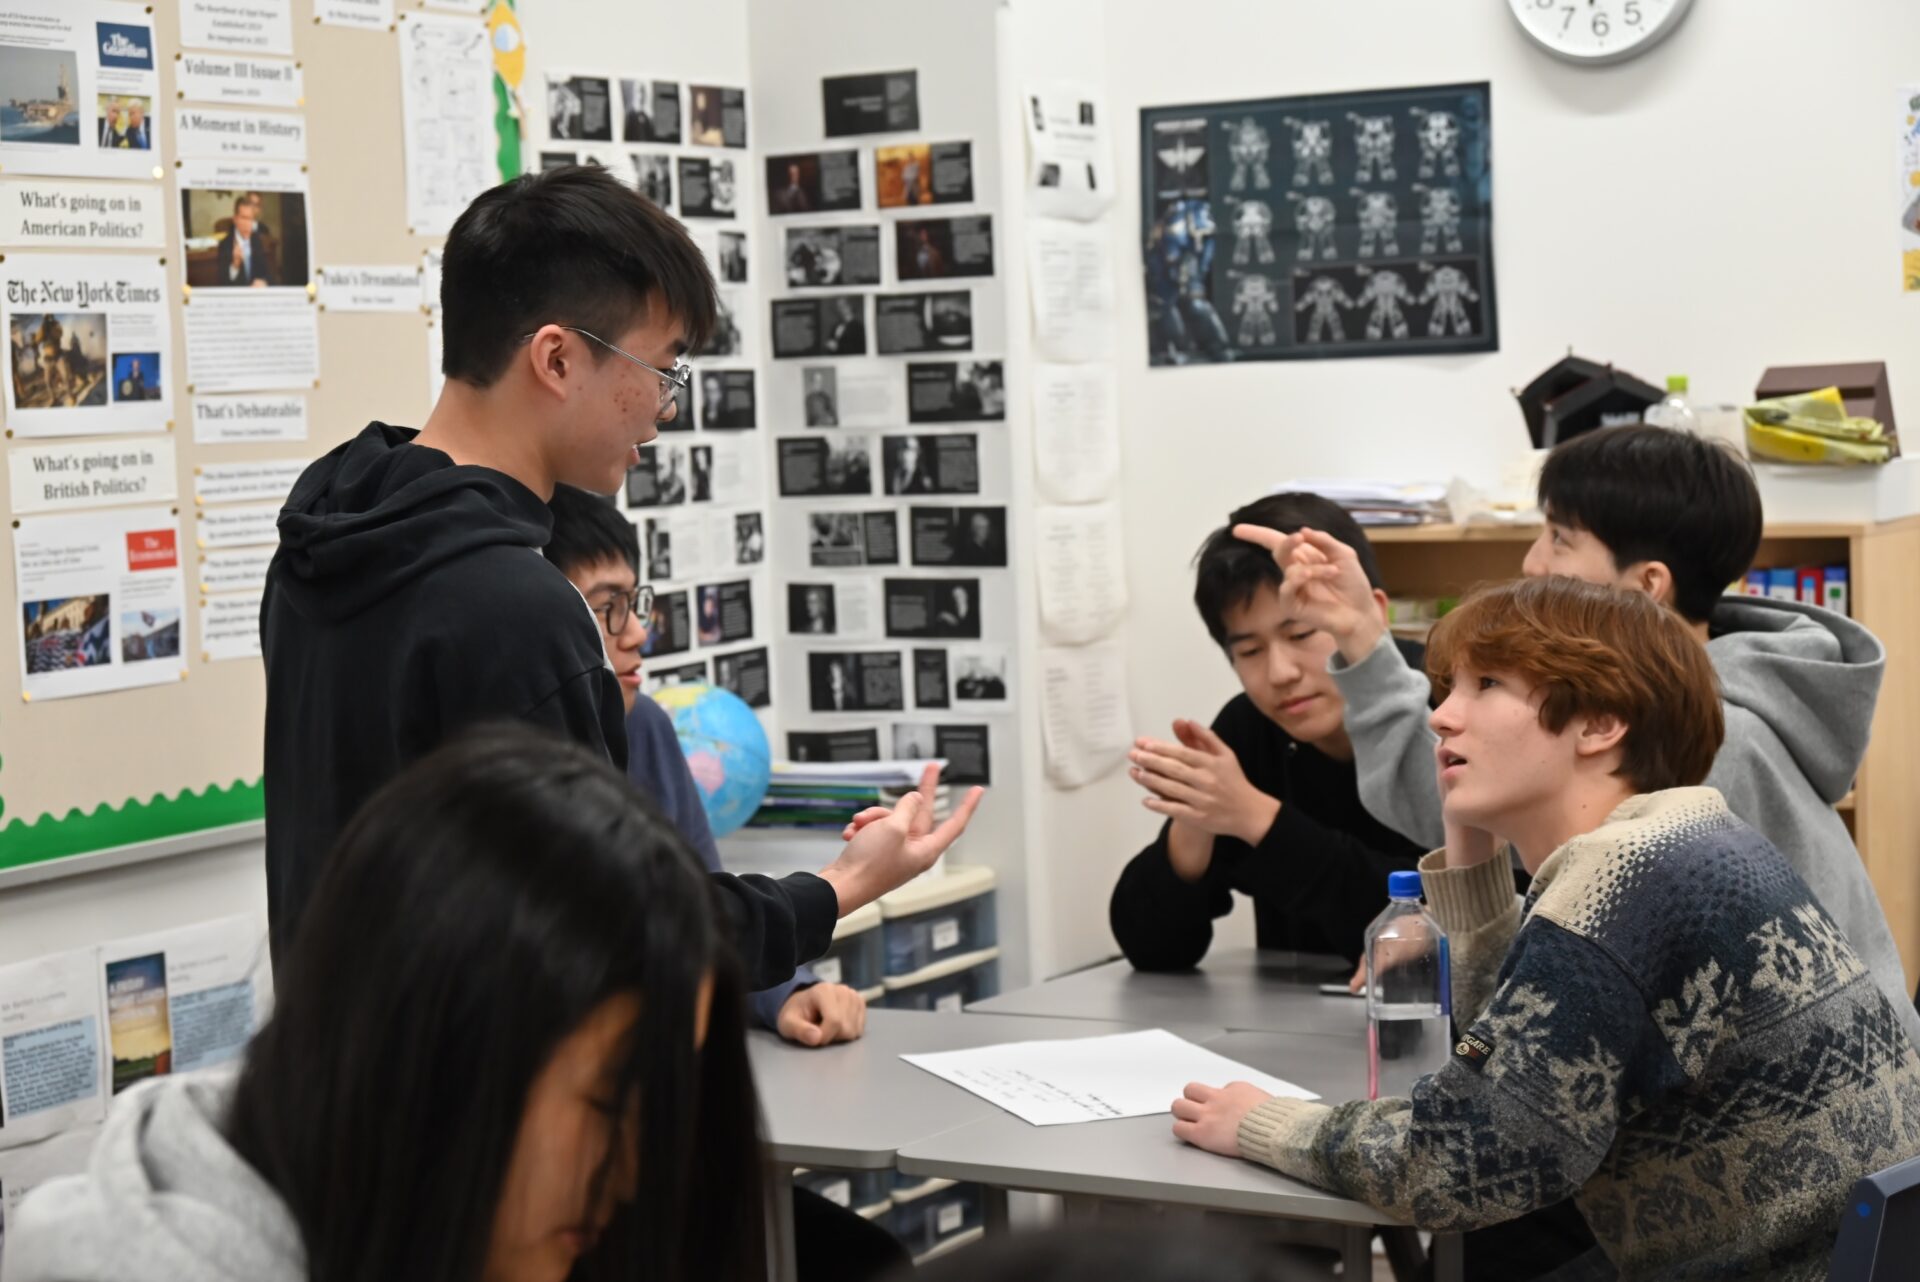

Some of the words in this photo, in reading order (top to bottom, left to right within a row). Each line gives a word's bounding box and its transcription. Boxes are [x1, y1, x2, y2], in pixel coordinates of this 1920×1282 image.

[1561, 5, 1576, 31] 7
[1591, 12, 1610, 38] 6
[1624, 1, 1642, 26] 5
[102, 40, 149, 59] Guardian
[109, 32, 130, 47] The
[184, 59, 231, 77] Volume
[250, 63, 281, 81] Issue
[180, 114, 188, 131] A
[191, 115, 241, 133] Moment
[244, 118, 255, 134] in
[258, 119, 301, 141] History
[20, 190, 67, 209] What's
[70, 194, 107, 214] going
[109, 197, 126, 212] on
[128, 194, 142, 212] in
[21, 219, 87, 237] American
[89, 221, 144, 239] Politics?
[360, 270, 420, 287] Dreamland
[7, 279, 38, 306] The
[41, 279, 74, 305] New
[77, 279, 114, 308] York
[116, 280, 161, 303] Times
[196, 402, 234, 419] That's
[33, 454, 80, 473] What's
[82, 452, 119, 474] going
[121, 452, 138, 467] on
[141, 450, 154, 466] in
[43, 481, 90, 500] British
[93, 476, 147, 496] Politics?
